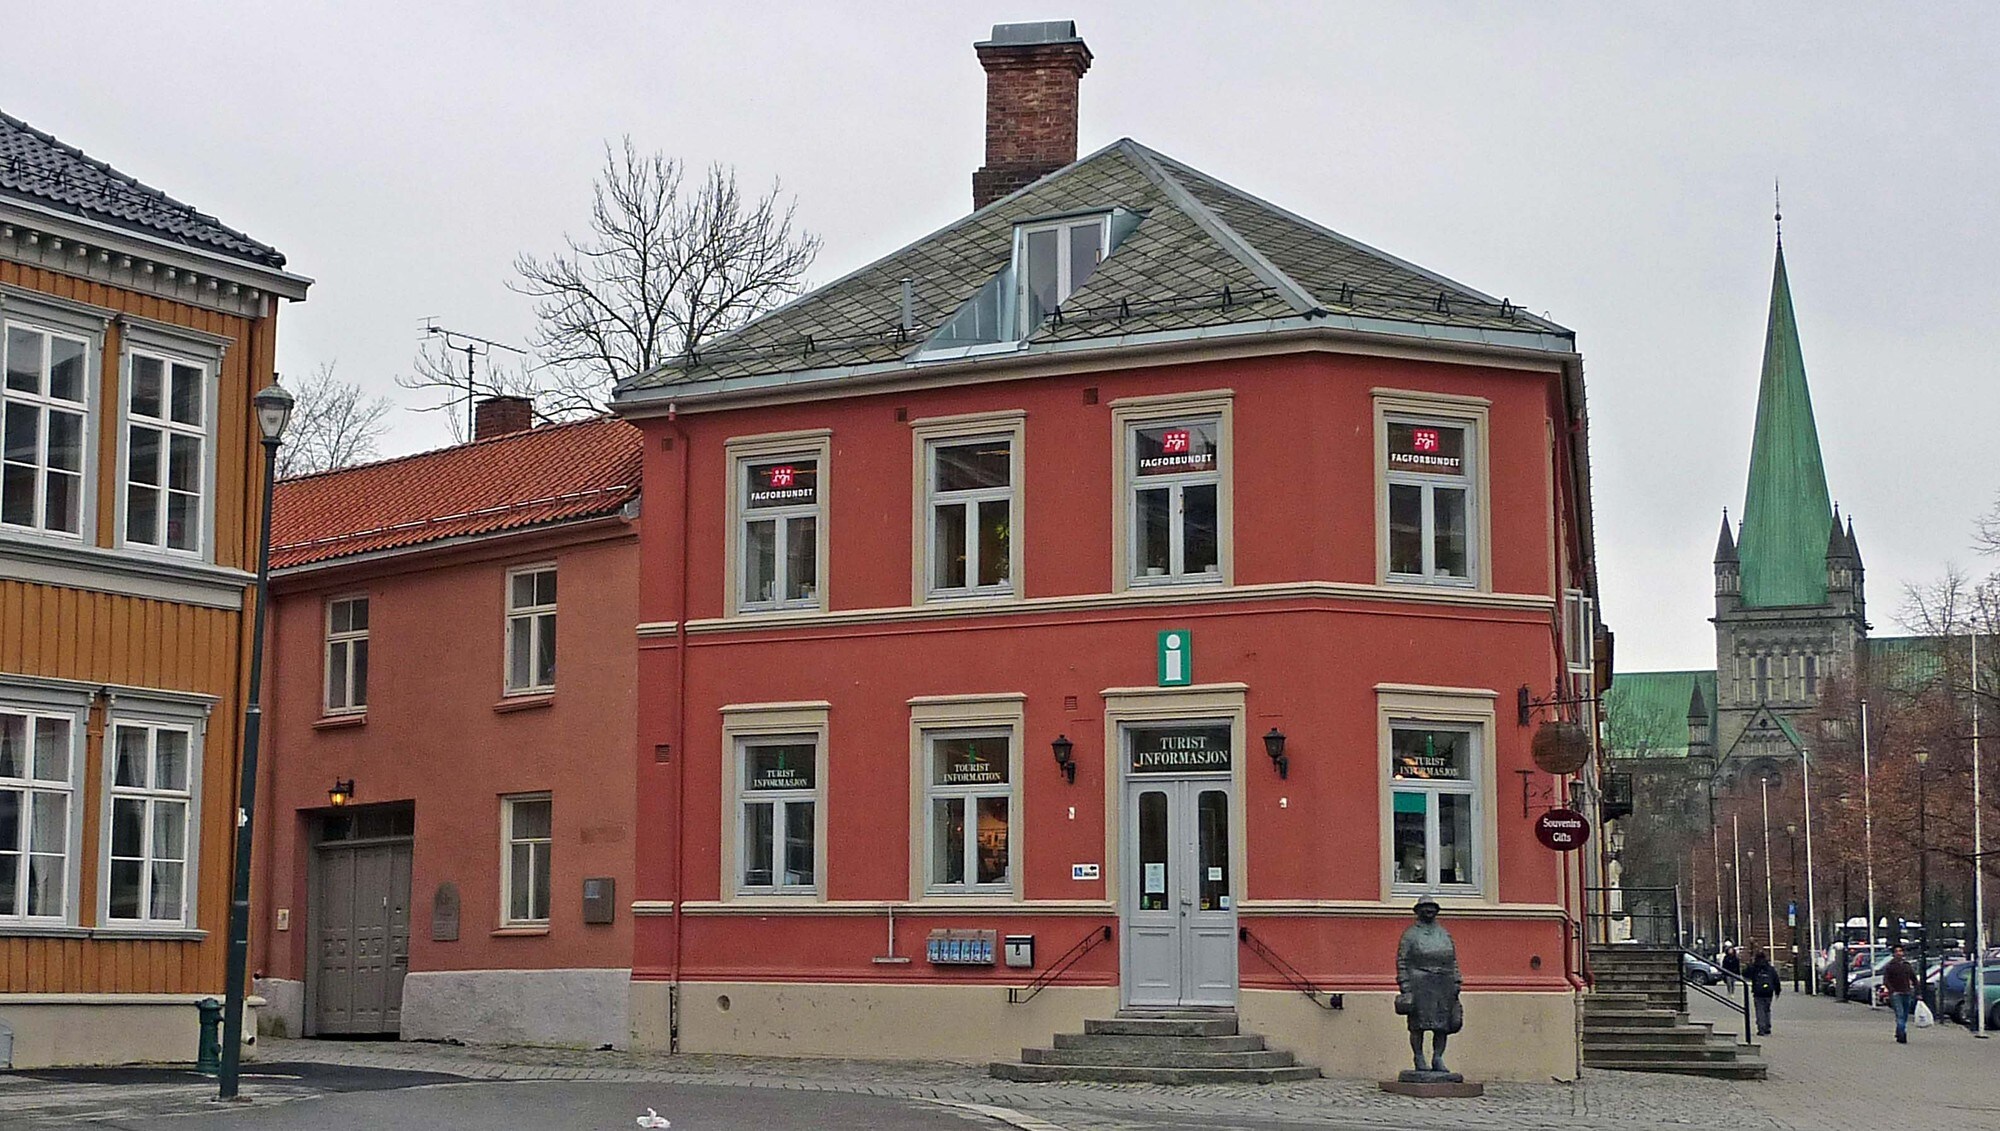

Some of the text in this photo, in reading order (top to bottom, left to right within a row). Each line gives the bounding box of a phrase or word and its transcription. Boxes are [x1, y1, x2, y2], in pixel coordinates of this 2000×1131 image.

[1140, 453, 1213, 468] FAGFORBUNDET
[1391, 453, 1460, 467] FAGFORBUNDET
[751, 488, 813, 501] FAGFORBUNDET
[1160, 736, 1207, 750] TURIST
[1140, 750, 1228, 766] INFORMASJON
[1415, 756, 1446, 766] TURIST
[954, 763, 991, 773] TOURIST
[766, 769, 795, 778] TURIST
[943, 772, 1002, 783] INFORMATION
[753, 778, 808, 788] INFORMASJON
[1543, 818, 1581, 828] Souvenirs
[1553, 832, 1571, 842] Gifts
